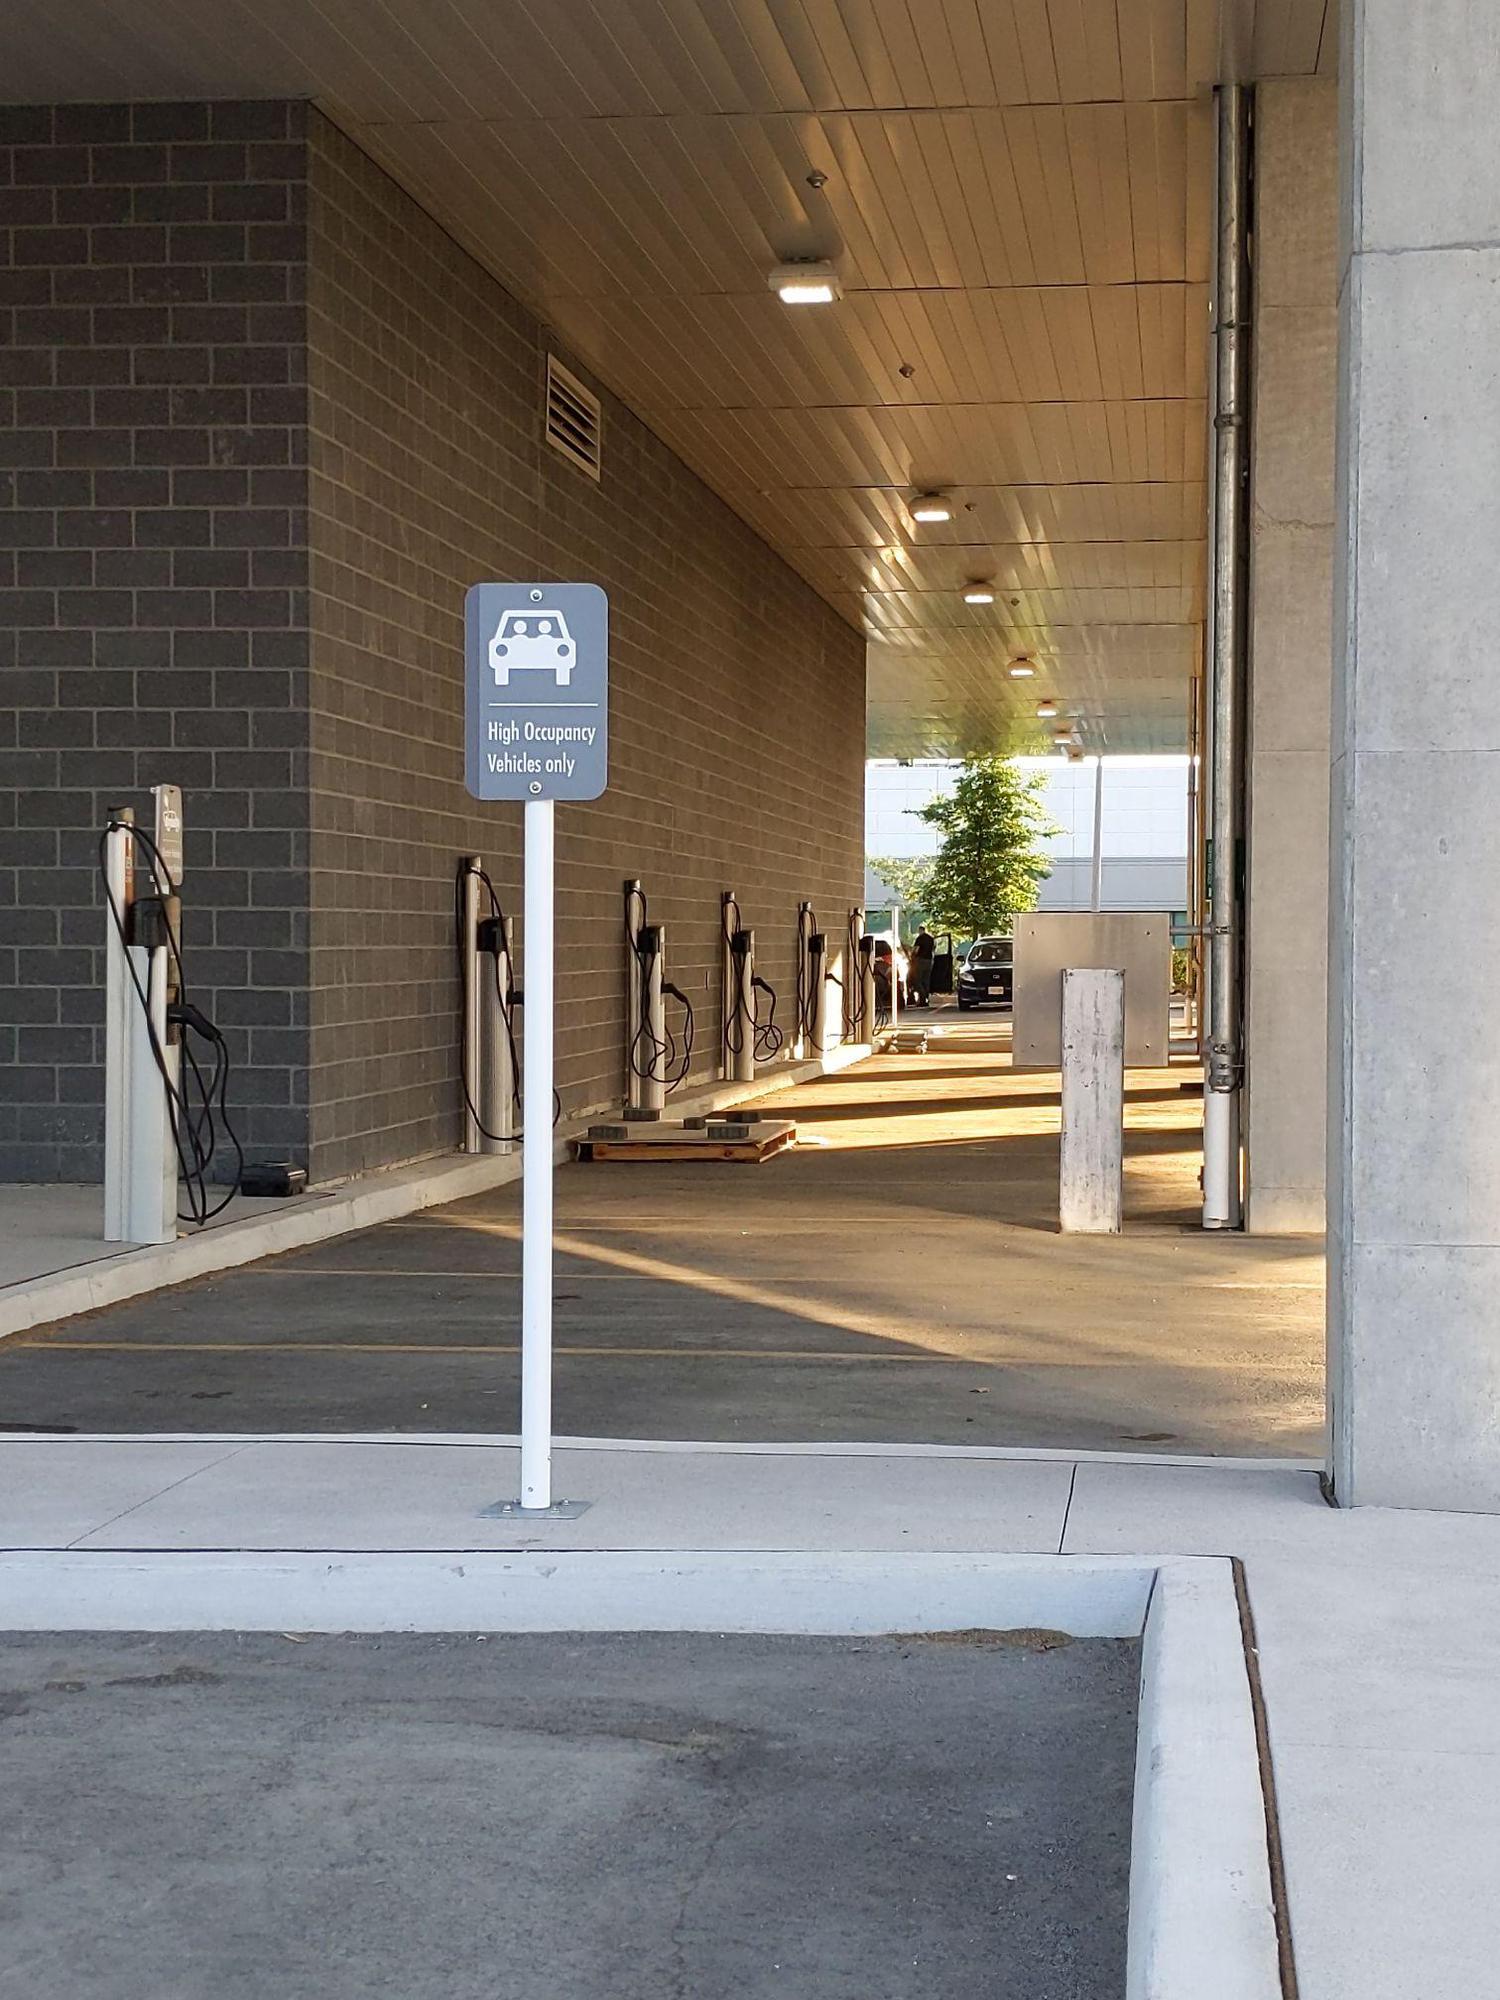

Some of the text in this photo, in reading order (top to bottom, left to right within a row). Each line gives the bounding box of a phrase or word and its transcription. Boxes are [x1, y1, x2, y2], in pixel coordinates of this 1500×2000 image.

[488, 720, 596, 746] High Occupancy
[487, 751, 576, 777] Vehicles only
